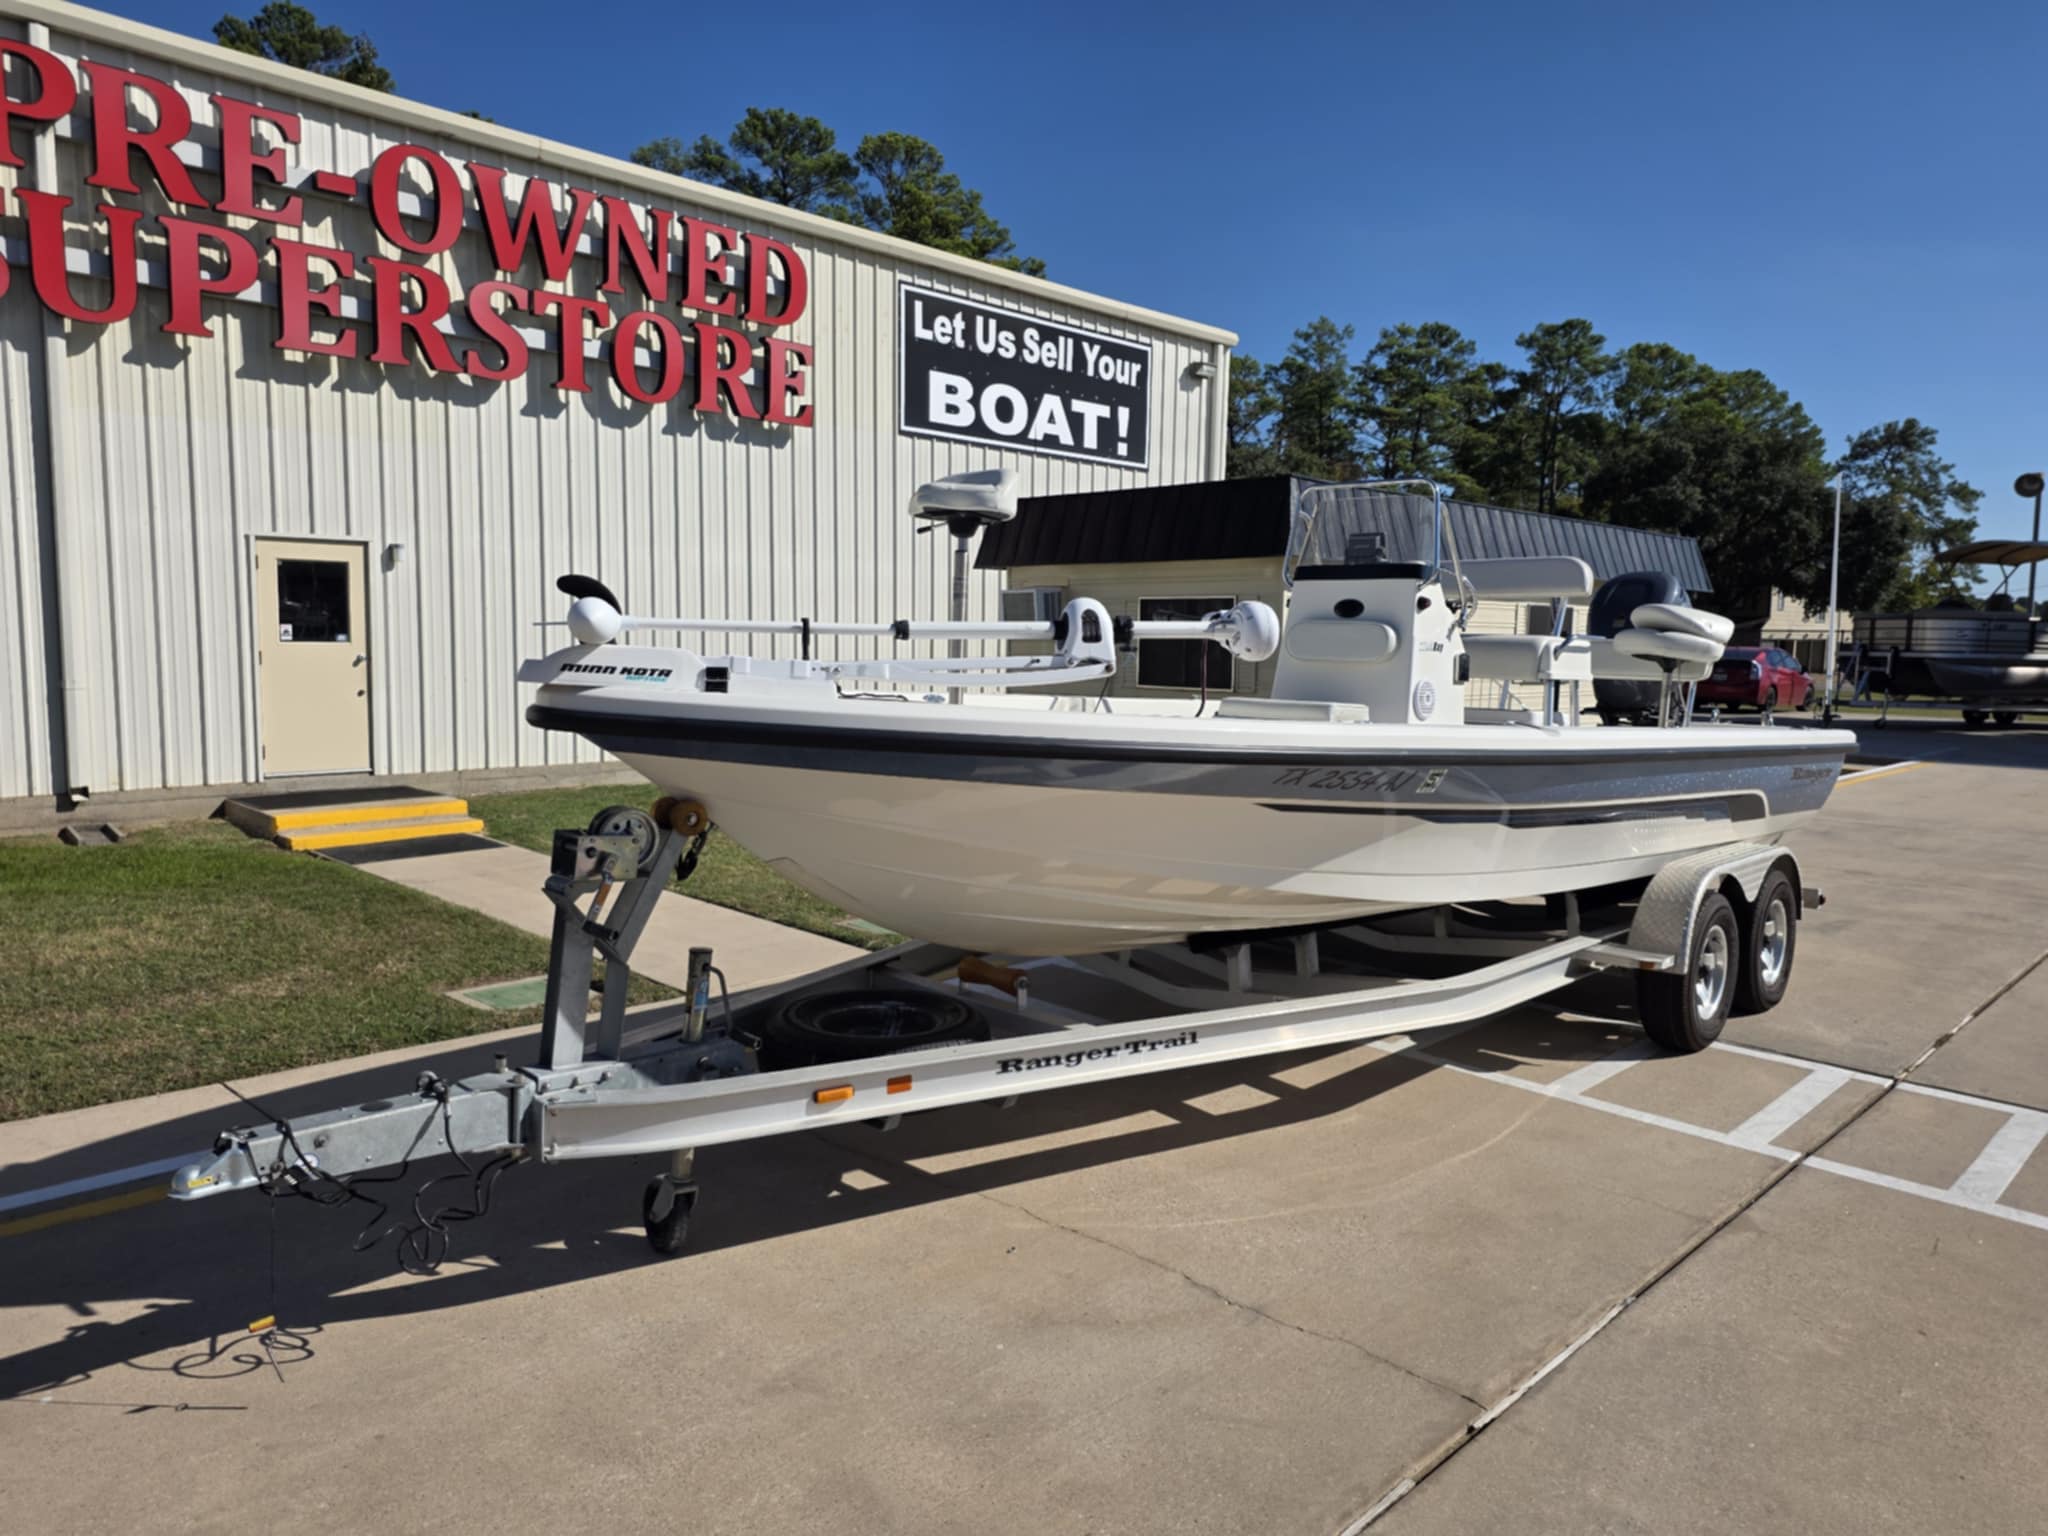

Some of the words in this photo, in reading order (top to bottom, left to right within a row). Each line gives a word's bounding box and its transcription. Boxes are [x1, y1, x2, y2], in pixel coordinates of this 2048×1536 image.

[0, 37, 809, 327] PRE-OWNED
[0, 187, 814, 428] UPERSTORE
[914, 300, 965, 348] Let
[975, 315, 1016, 358] Us
[1022, 327, 1074, 372] Sell
[1082, 341, 1141, 387] Your
[929, 369, 1130, 457] BOAT!
[620, 666, 673, 677] KOTA
[1273, 768, 1318, 786] TX
